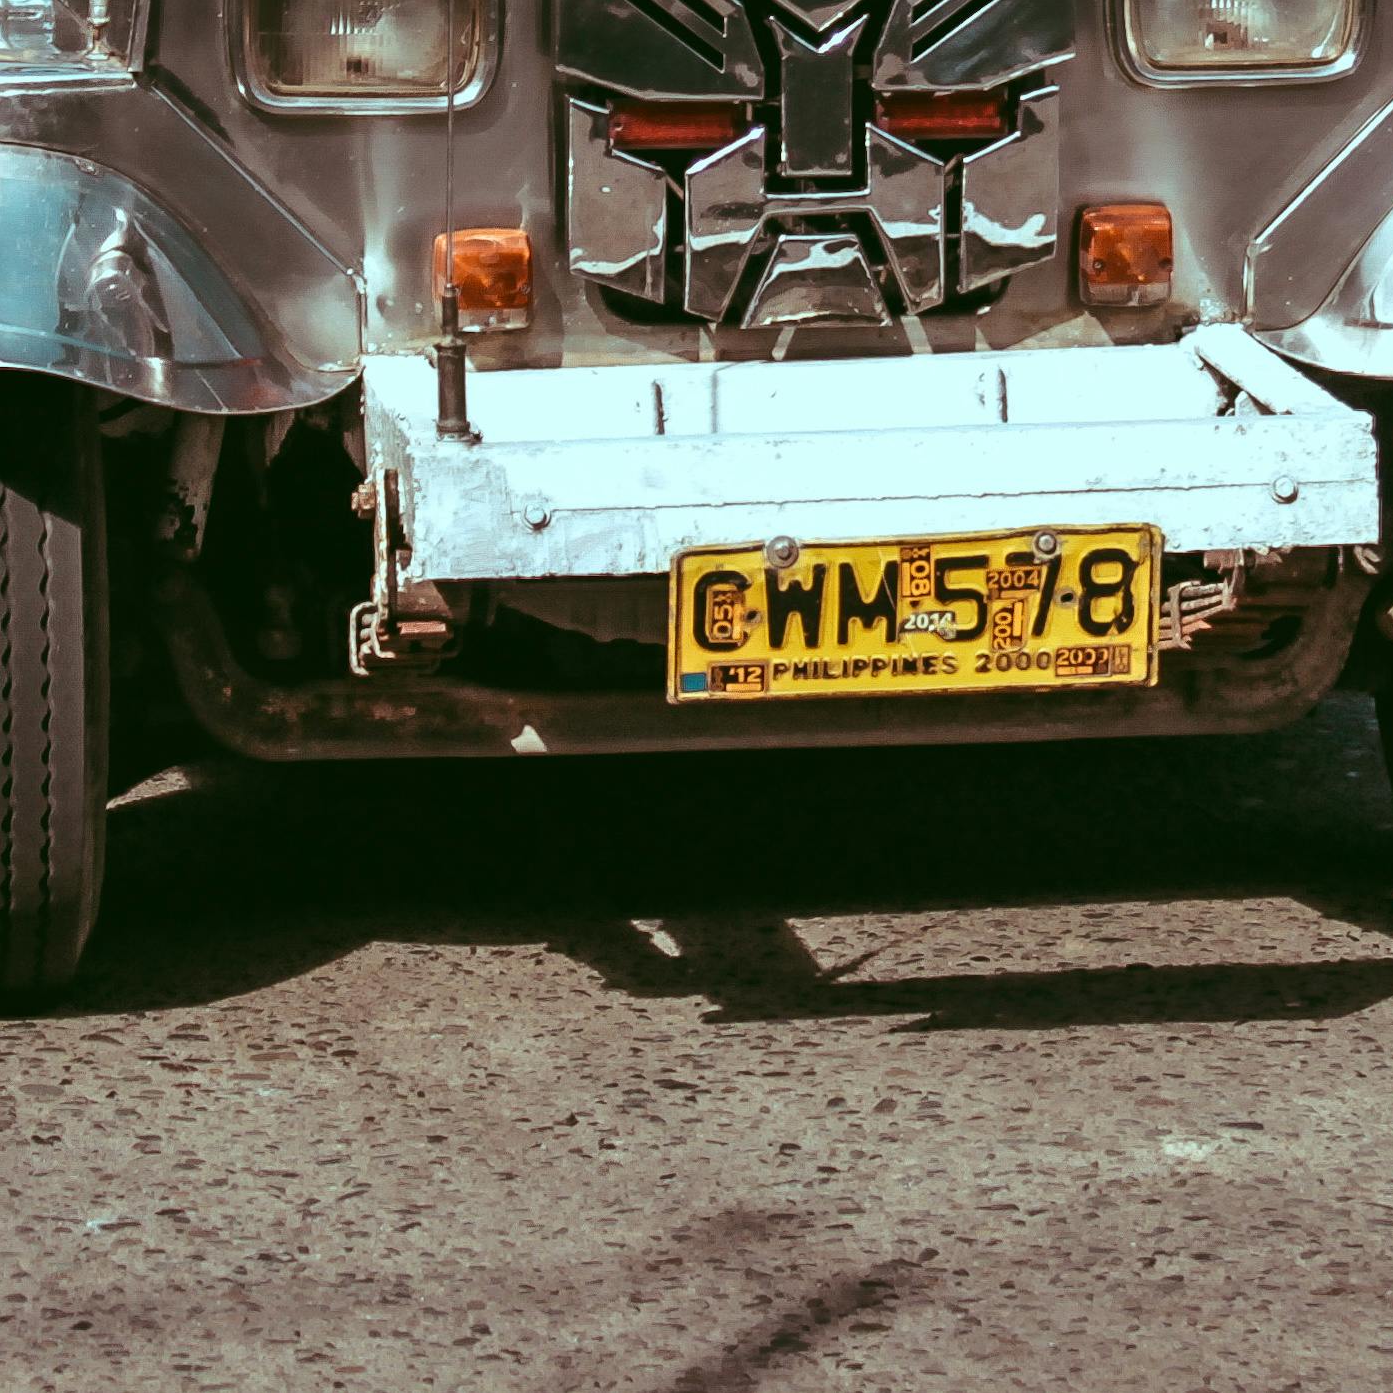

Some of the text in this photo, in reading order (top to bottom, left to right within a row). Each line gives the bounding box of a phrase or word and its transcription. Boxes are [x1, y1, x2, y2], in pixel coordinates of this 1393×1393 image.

[987, 569, 1041, 589] 2004
[693, 548, 1136, 653] CWM 578
[773, 649, 1052, 681] PHILIPPINES 2000
